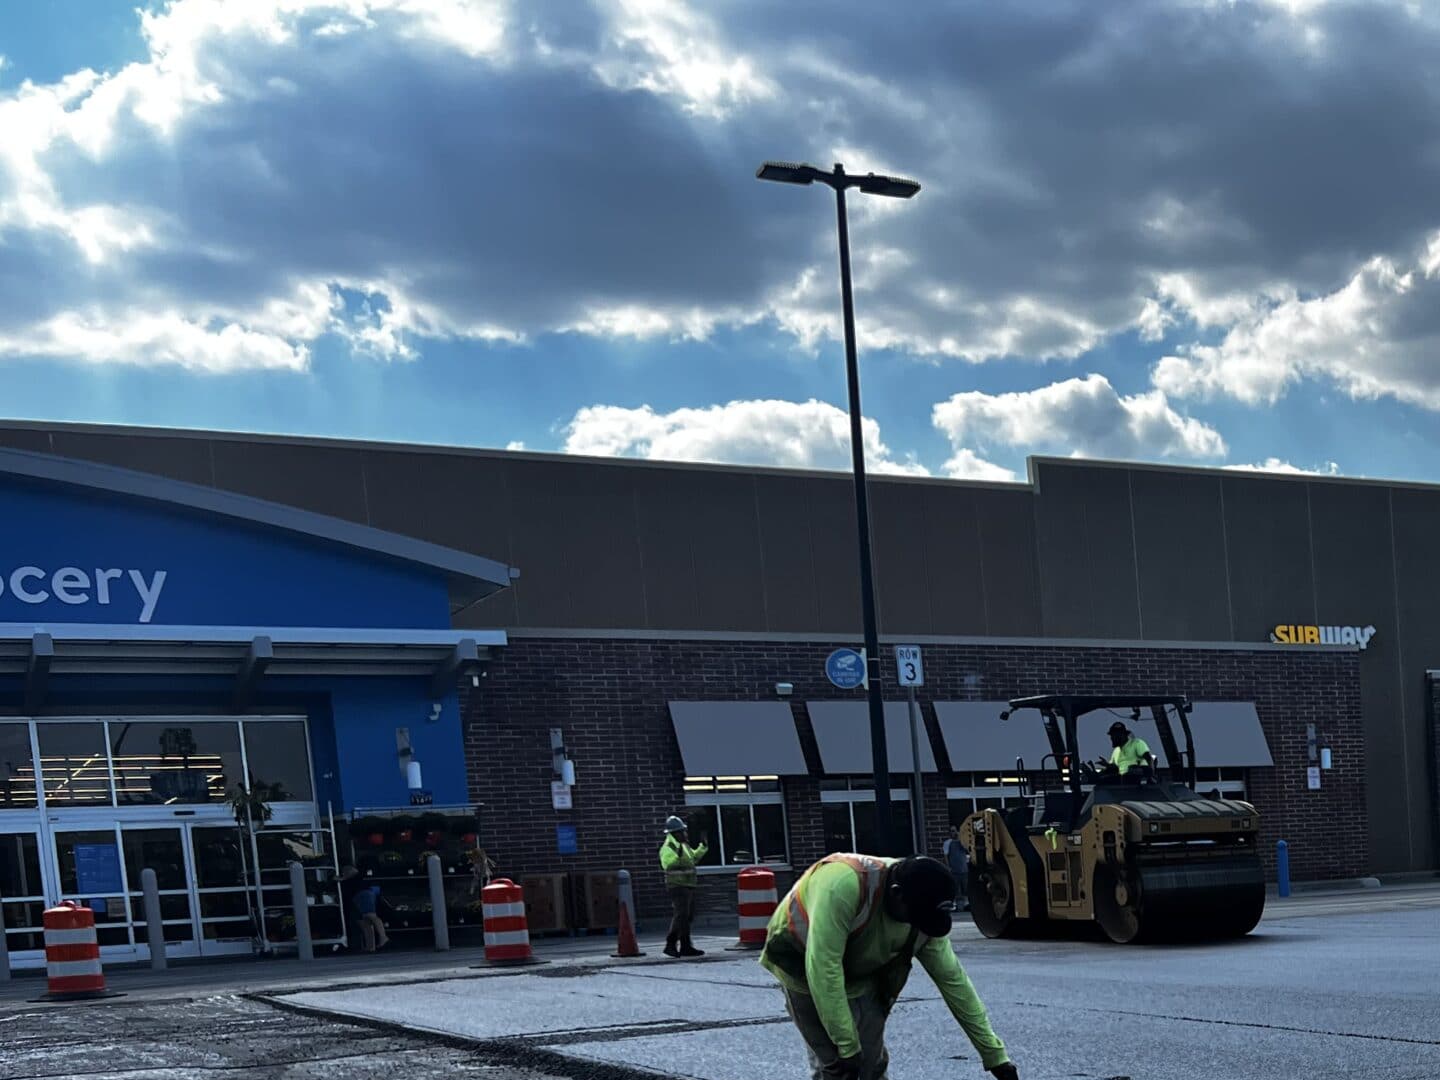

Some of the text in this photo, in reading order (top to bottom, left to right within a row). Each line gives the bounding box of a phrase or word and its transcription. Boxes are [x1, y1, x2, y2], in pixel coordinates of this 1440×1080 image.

[0, 566, 168, 623] cery
[1270, 625, 1376, 649] SUBWAY
[899, 649, 918, 660] ROW
[905, 662, 917, 680] 3
